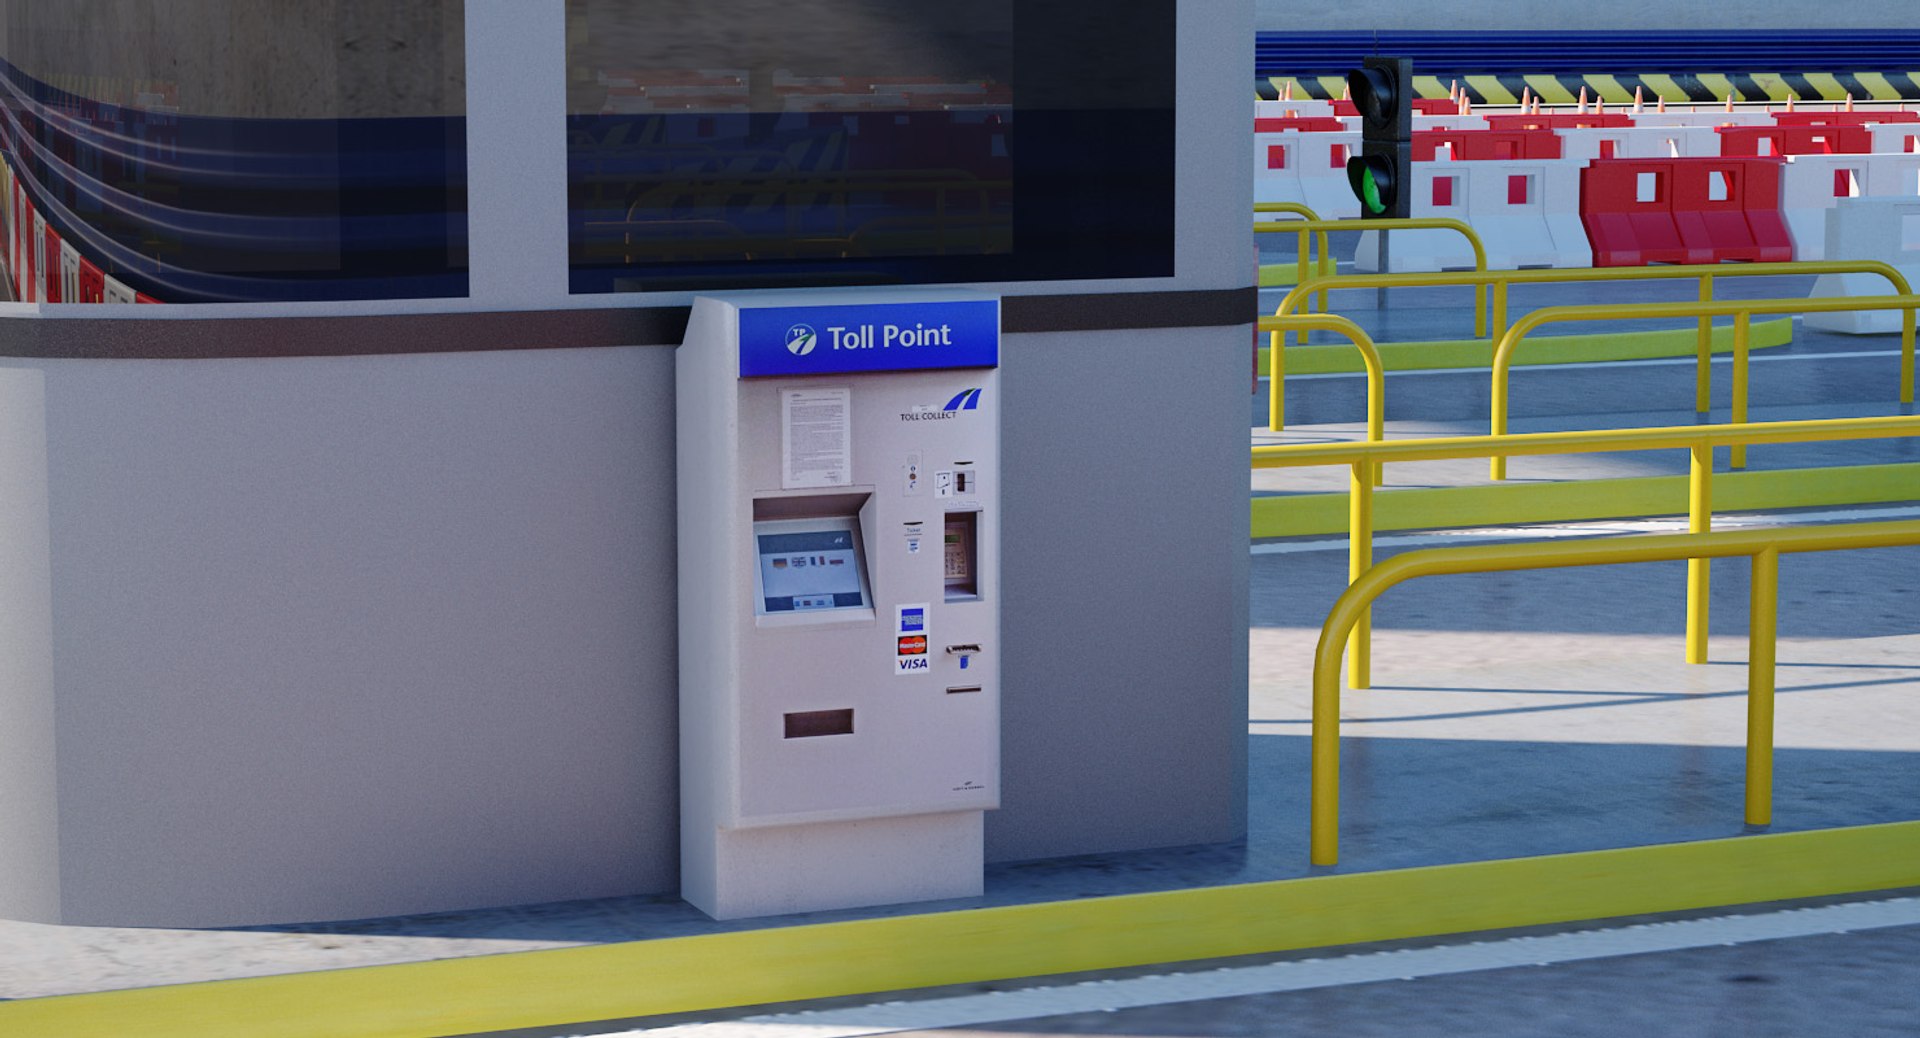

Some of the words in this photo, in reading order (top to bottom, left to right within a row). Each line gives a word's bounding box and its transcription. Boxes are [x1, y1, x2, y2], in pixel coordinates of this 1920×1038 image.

[793, 328, 806, 336] TP
[827, 325, 874, 350] Toll
[883, 323, 952, 347] Point
[900, 413, 919, 421] TOLL
[921, 411, 957, 420] COLLECT
[899, 658, 928, 669] VISA
